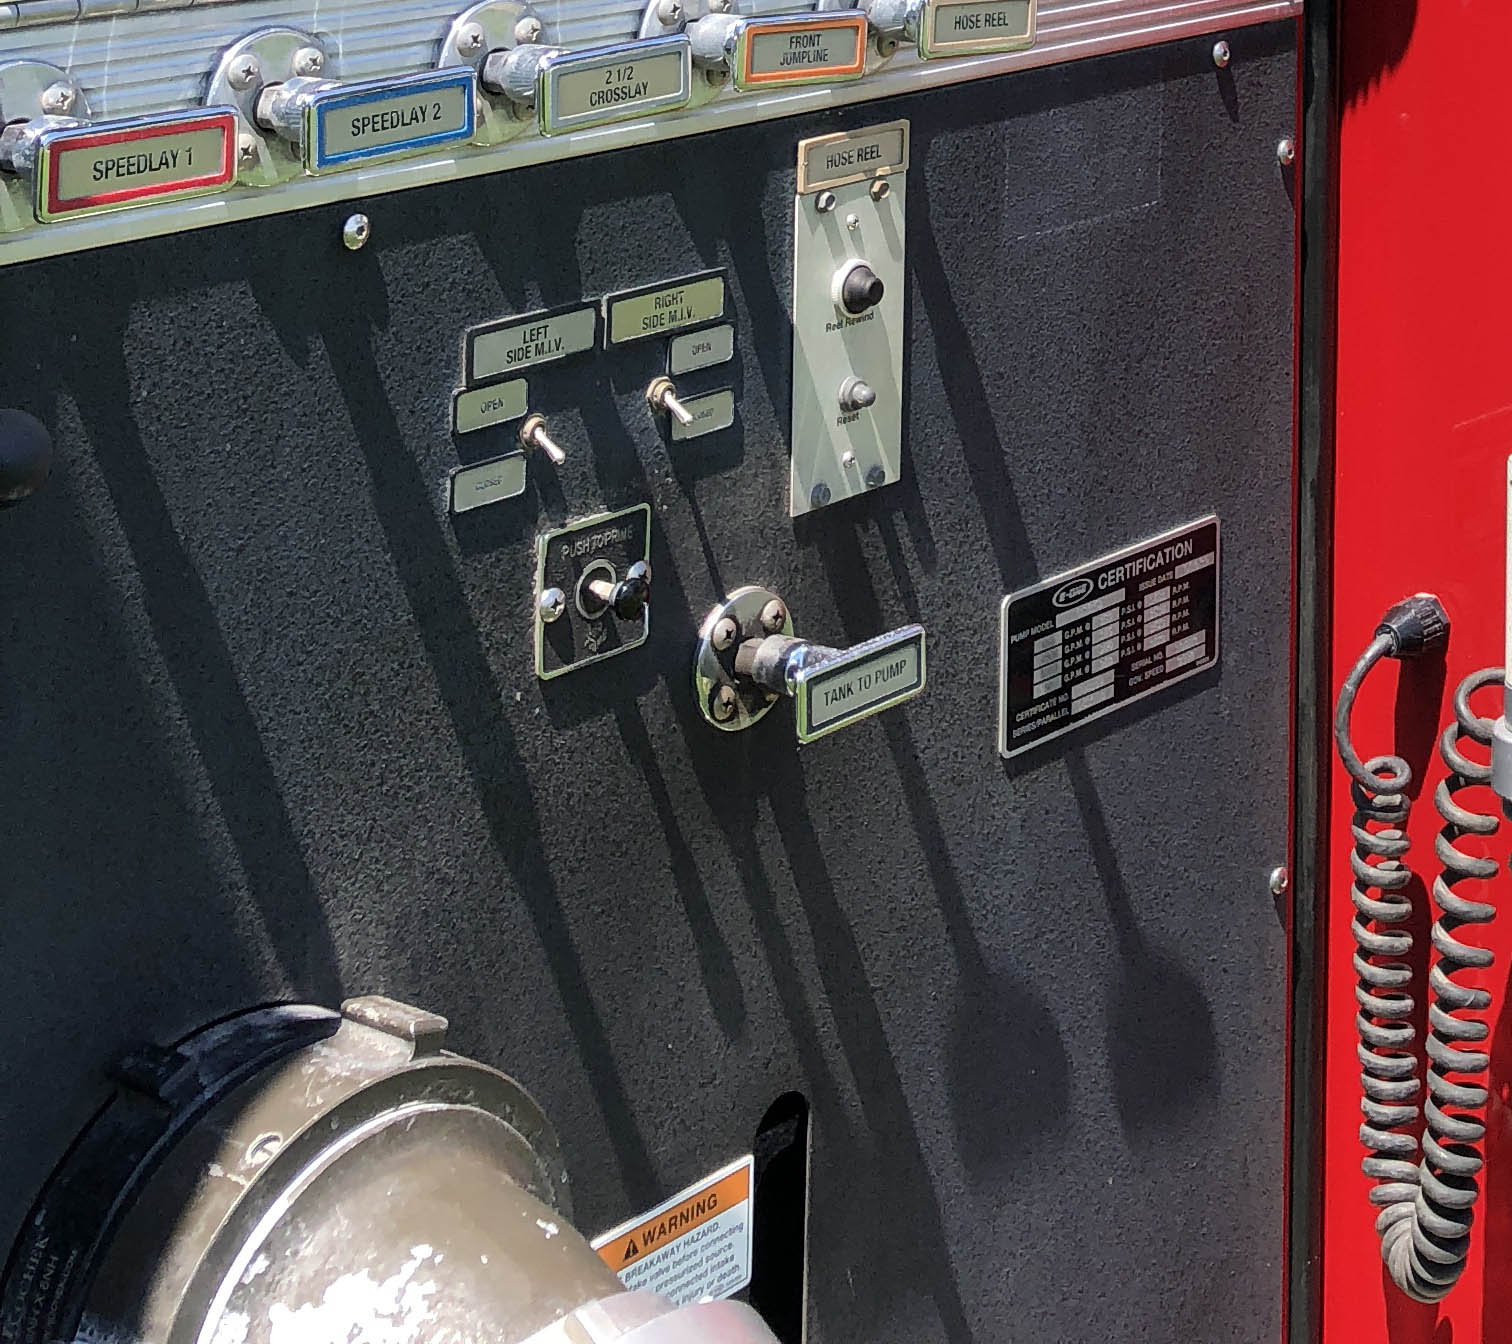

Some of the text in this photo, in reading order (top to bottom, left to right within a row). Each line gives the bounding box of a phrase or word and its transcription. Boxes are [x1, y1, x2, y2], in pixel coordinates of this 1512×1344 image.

[953, 10, 1009, 31] HOSE REEL
[788, 33, 822, 51] FRONT
[779, 47, 829, 67] JUMPLINE
[604, 65, 634, 86] 2 1/2
[589, 81, 649, 108] CROSSLAY
[350, 102, 442, 138] SPEEDLAY 2
[92, 146, 193, 181] SPEEDLAY 1
[825, 143, 882, 170] HOSE REEL
[654, 290, 685, 310] RIGHT
[641, 306, 696, 331] SIDE M.I.V.
[825, 312, 875, 333] Reel Rewind
[522, 324, 549, 345] LEFT
[506, 337, 566, 364] SIDE M.I.V.
[691, 341, 712, 356] OPEN
[479, 398, 505, 414] OPEN
[836, 411, 860, 427] Reset
[560, 524, 633, 561] PUSH TO PRIME
[1097, 538, 1193, 590] CERTIFICATION
[1139, 570, 1174, 592] ISSUE DATE
[1010, 619, 1055, 645] PUMP MODEL
[1130, 656, 1153, 672] SERIAL
[1145, 664, 1165, 679] SPEED
[823, 659, 907, 707] TANK TO PUMP
[1012, 707, 1070, 738] SERIES/PARALLEL
[1015, 699, 1057, 723] CERTIFICATE
[642, 1193, 718, 1248] WARNING
[624, 1243, 681, 1283] BREAKAWAY
[649, 1222, 744, 1282] valve before connecting
[710, 1254, 735, 1273] intake
[655, 1256, 704, 1292] pressurized
[681, 1286, 705, 1305] injury
[706, 1278, 715, 1290] or
[716, 1264, 740, 1283] death
